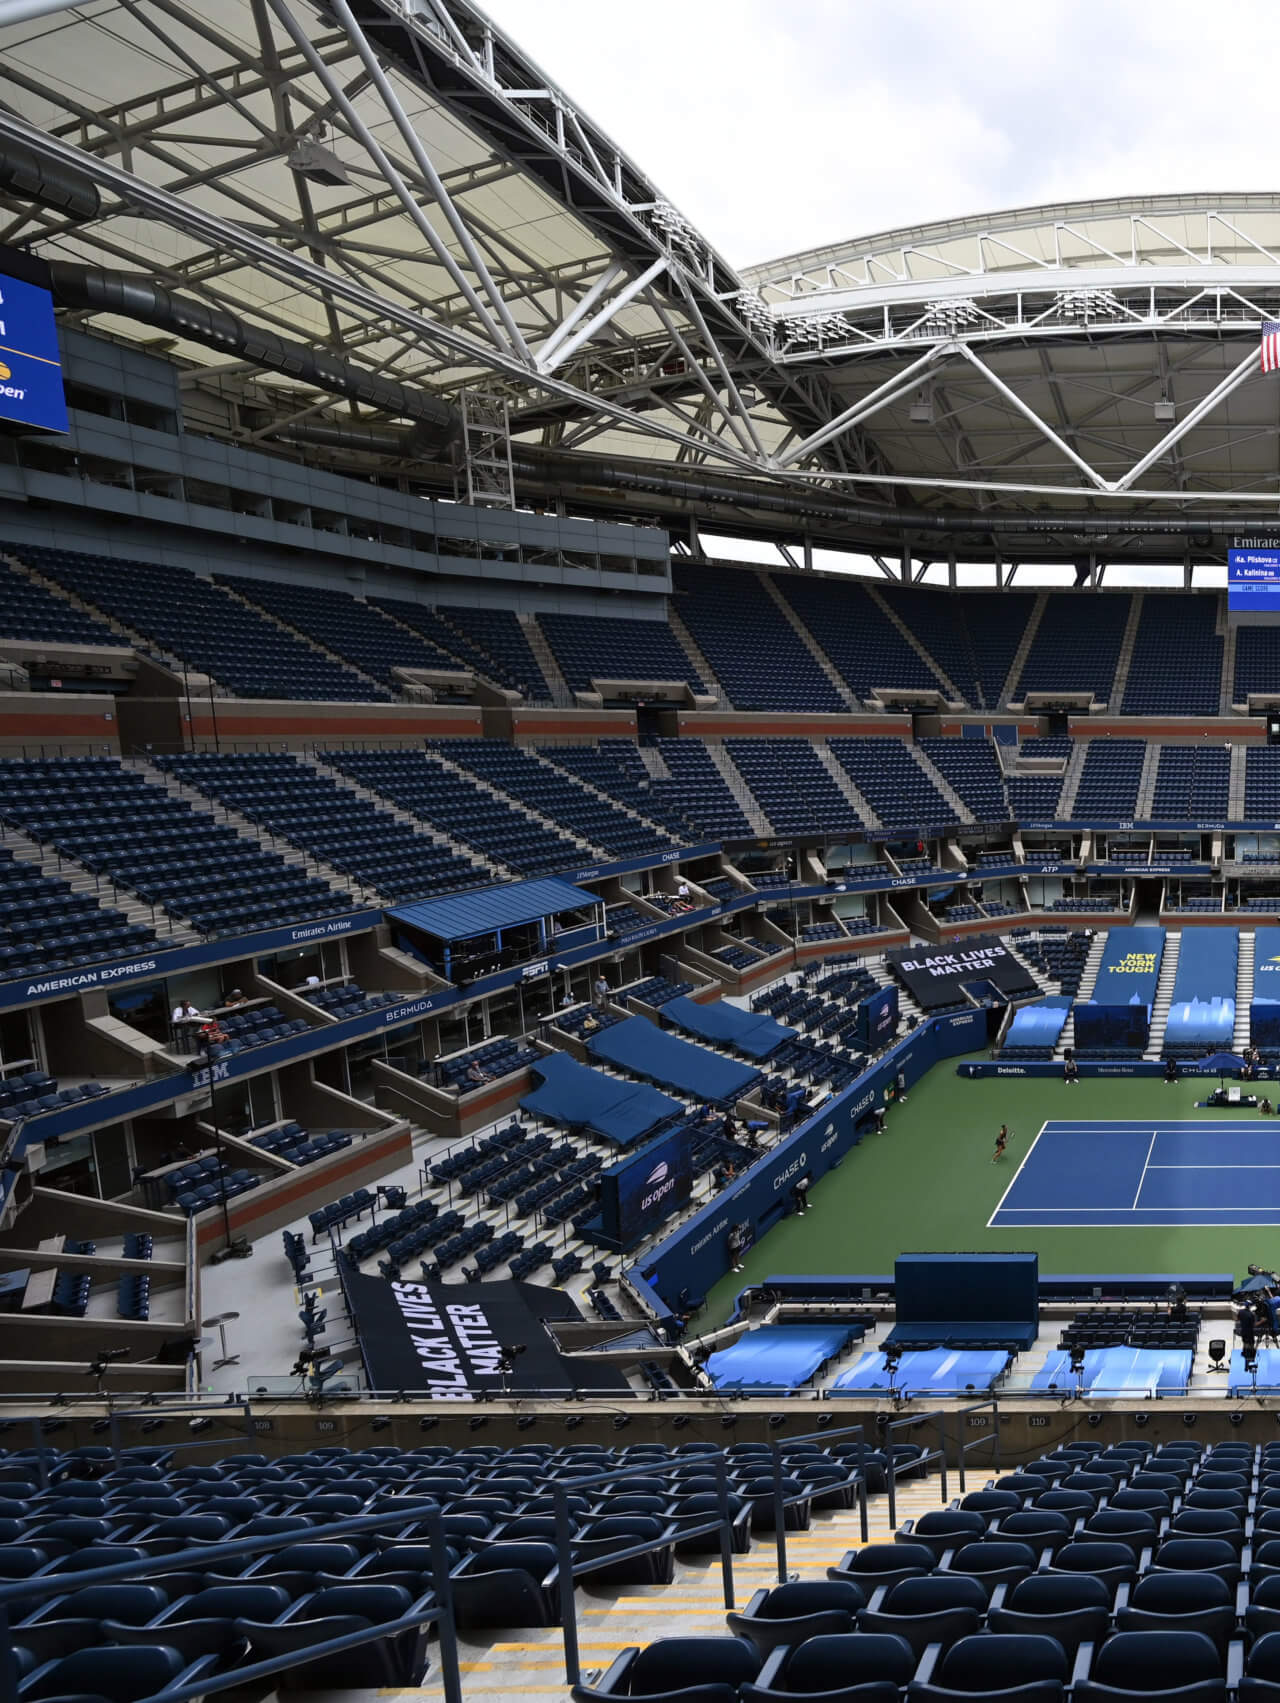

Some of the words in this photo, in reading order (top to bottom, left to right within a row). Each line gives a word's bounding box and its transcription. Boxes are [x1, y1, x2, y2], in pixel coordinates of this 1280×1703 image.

[662, 852, 680, 862] CHASE
[892, 877, 916, 886] CHASE
[291, 926, 325, 940] Emirates
[326, 920, 352, 935] Airline
[522, 960, 548, 977] ESPN
[900, 953, 958, 972] BLACK
[960, 946, 1006, 962] LIVES
[929, 958, 996, 977] MATTER
[1119, 959, 1155, 967] YORK
[26, 972, 97, 996] AMERICAN
[100, 960, 156, 980] EXPRESS
[386, 1000, 432, 1021] BERMUDA
[192, 1061, 230, 1088] IBM
[850, 1095, 870, 1119] CHASE
[773, 1162, 799, 1190] CHASE
[641, 1194, 652, 1210] us
[653, 1178, 675, 1202] open
[391, 1281, 444, 1330] LIVES
[446, 1304, 513, 1375] MATTER
[410, 1334, 475, 1400] BLACK
[970, 1418, 986, 1426] 109
